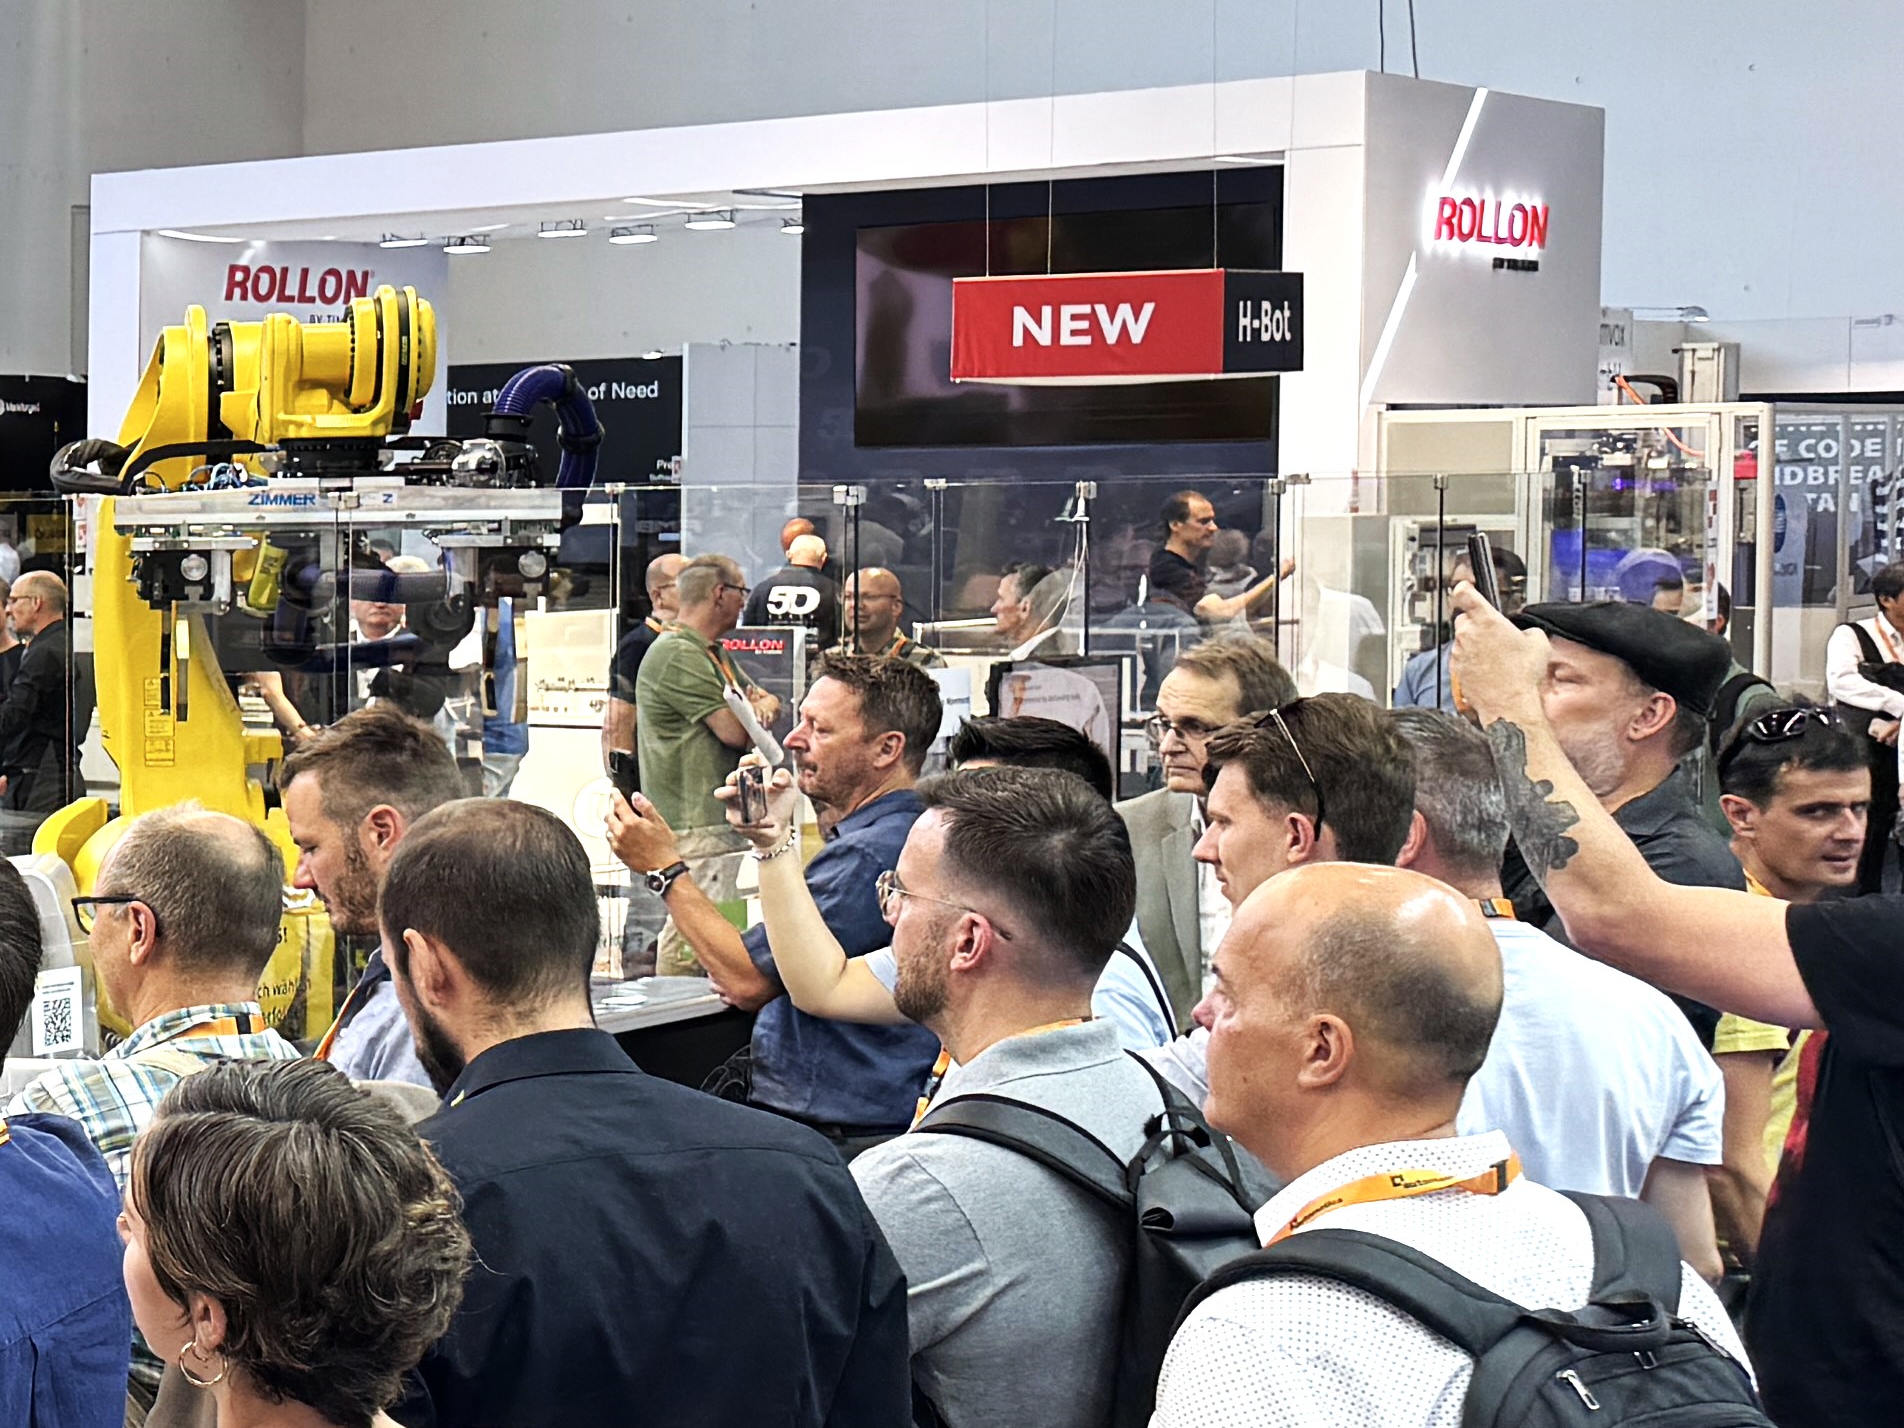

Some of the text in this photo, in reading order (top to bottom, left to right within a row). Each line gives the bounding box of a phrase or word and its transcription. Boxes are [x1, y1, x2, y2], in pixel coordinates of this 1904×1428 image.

[1434, 196, 1549, 250] ROLLON
[224, 264, 369, 305] ROLLON
[1011, 301, 1155, 347] NEW
[1237, 297, 1292, 345] H-Bot
[587, 381, 607, 400] of
[612, 380, 659, 399] Need
[248, 493, 316, 506] ZIMMER
